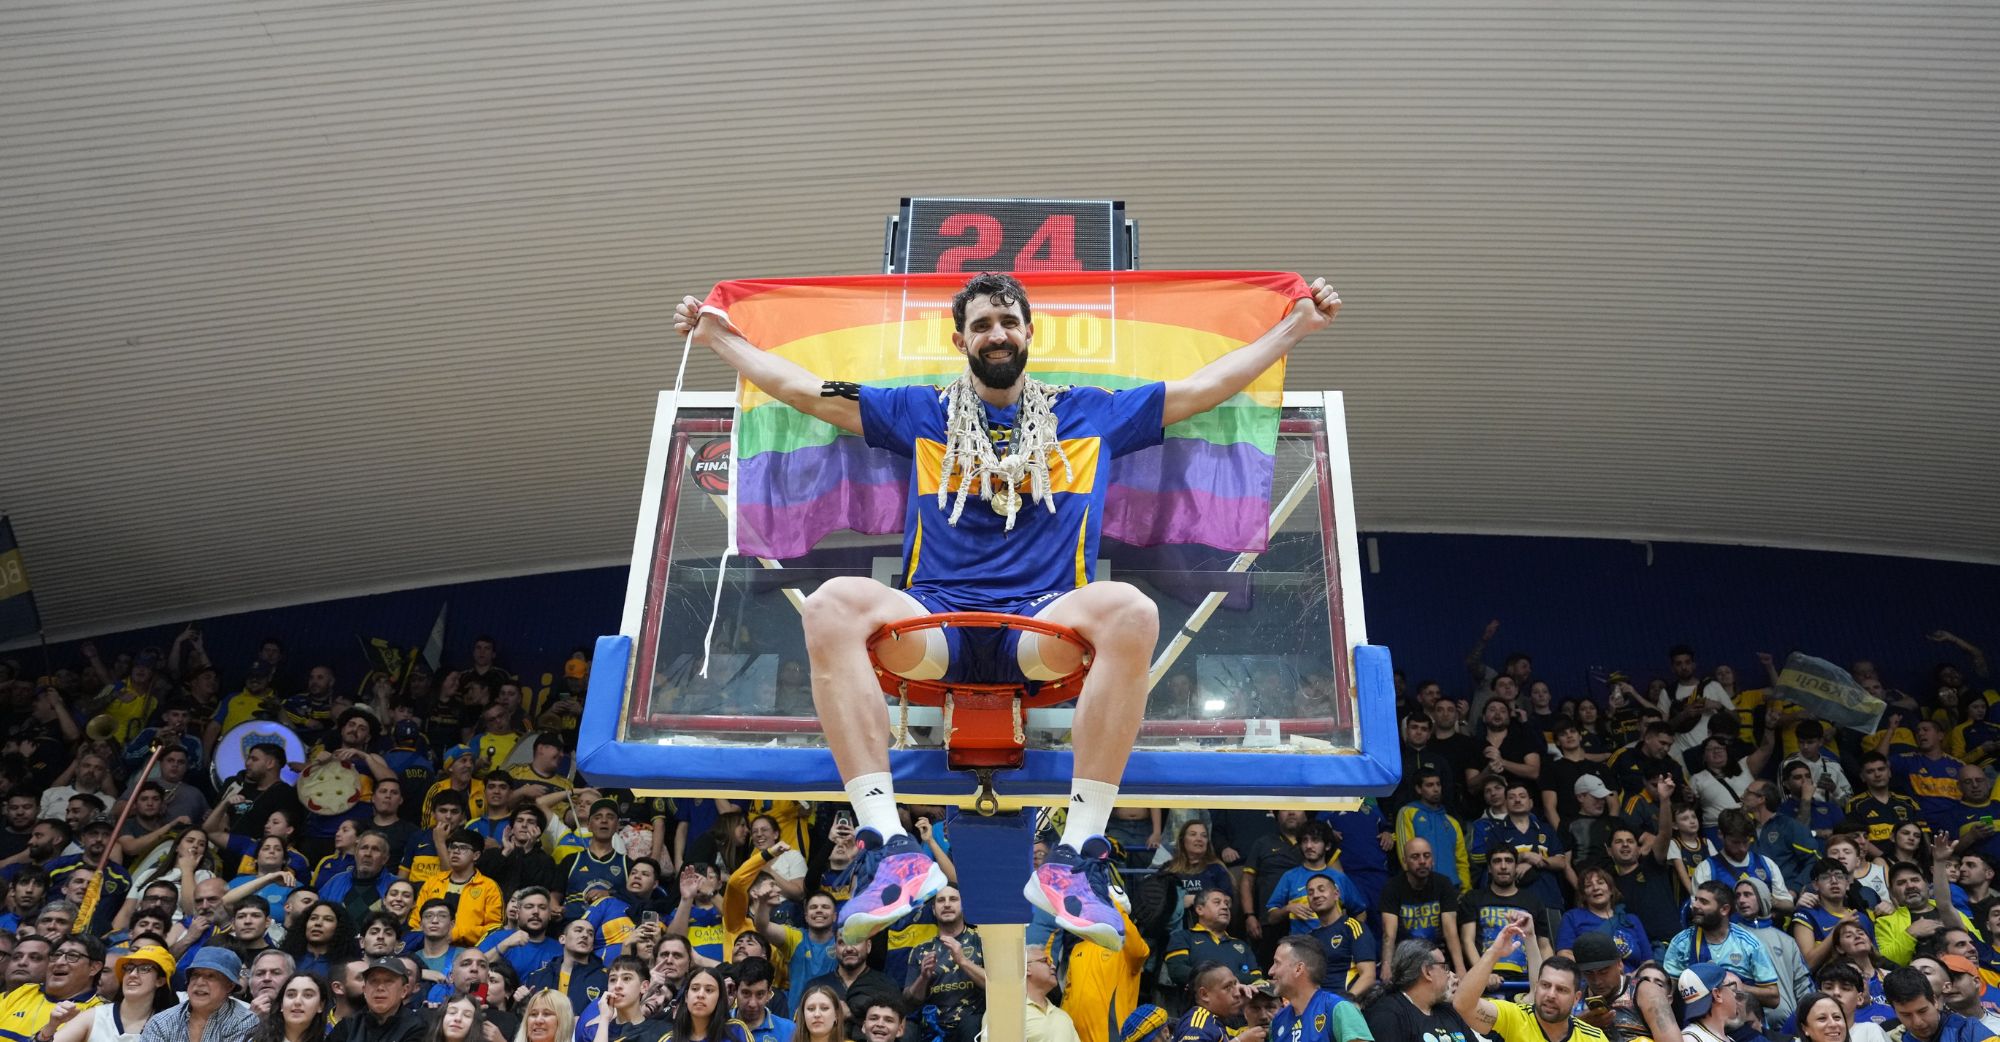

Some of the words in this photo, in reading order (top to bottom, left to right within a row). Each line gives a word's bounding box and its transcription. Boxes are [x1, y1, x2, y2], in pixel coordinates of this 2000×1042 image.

[936, 213, 1083, 273] 24
[695, 461, 729, 472] FINA
[416, 862, 438, 873] QAT
[1181, 879, 1202, 888] TAR
[1400, 902, 1441, 919] DIEGO
[1480, 907, 1506, 919] DIE
[930, 980, 974, 994] etsson
